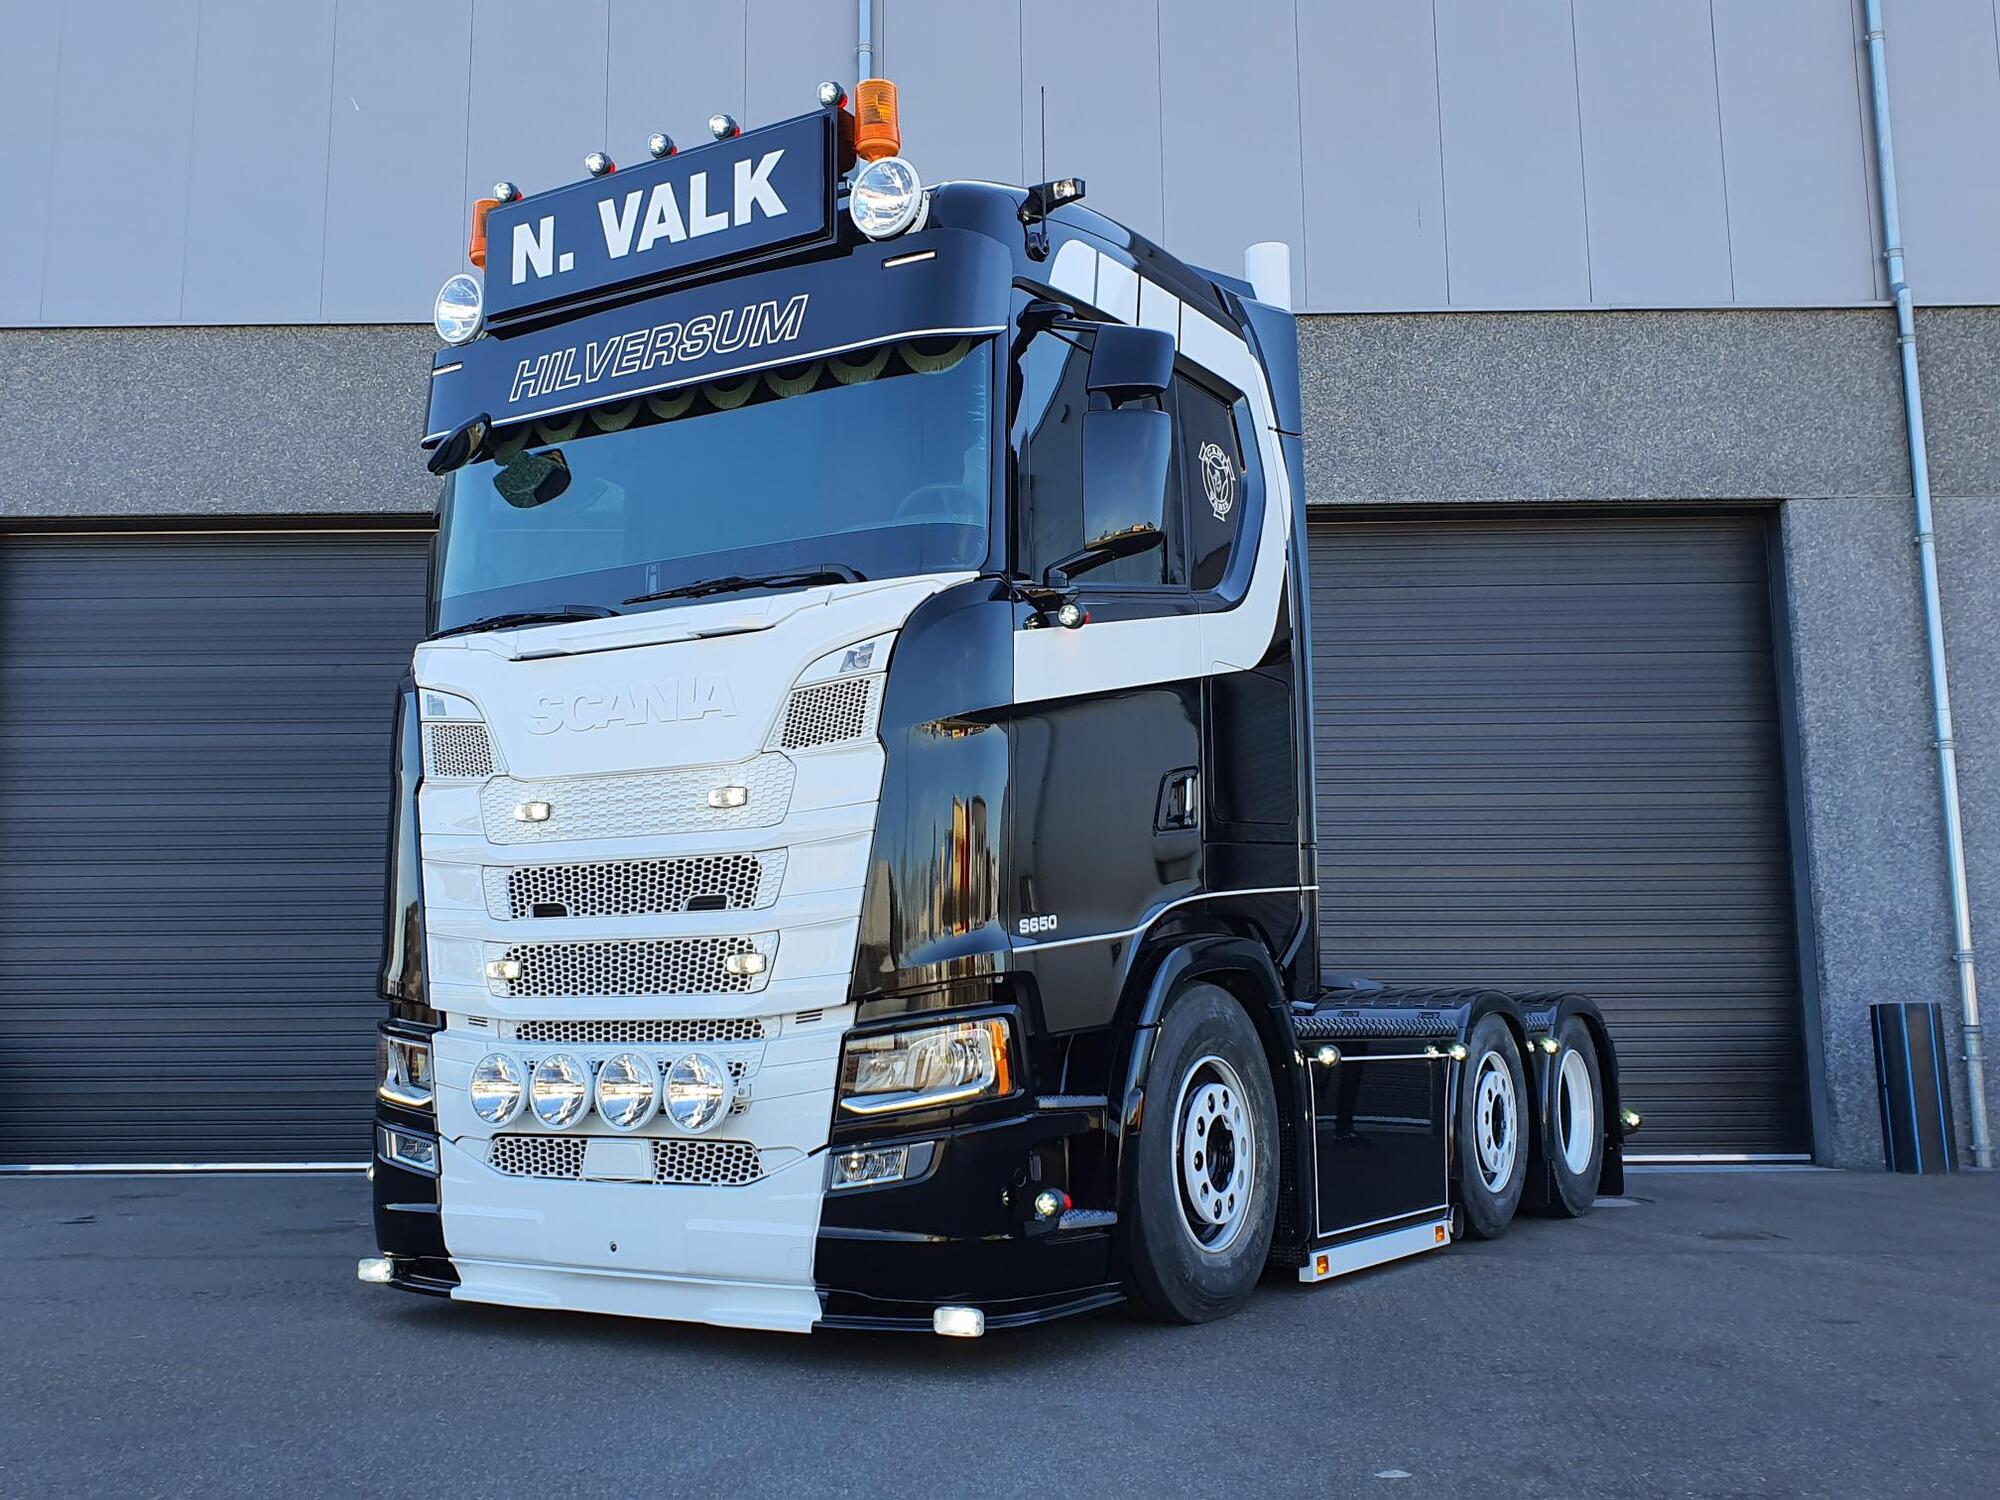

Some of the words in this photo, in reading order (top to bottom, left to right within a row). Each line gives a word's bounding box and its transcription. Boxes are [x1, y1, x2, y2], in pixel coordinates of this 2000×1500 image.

[511, 215, 574, 286] N.
[597, 149, 789, 260] VALK
[508, 293, 810, 403] HILVERSUM
[527, 673, 738, 736] SCANIA
[1018, 914, 1058, 934] S650
